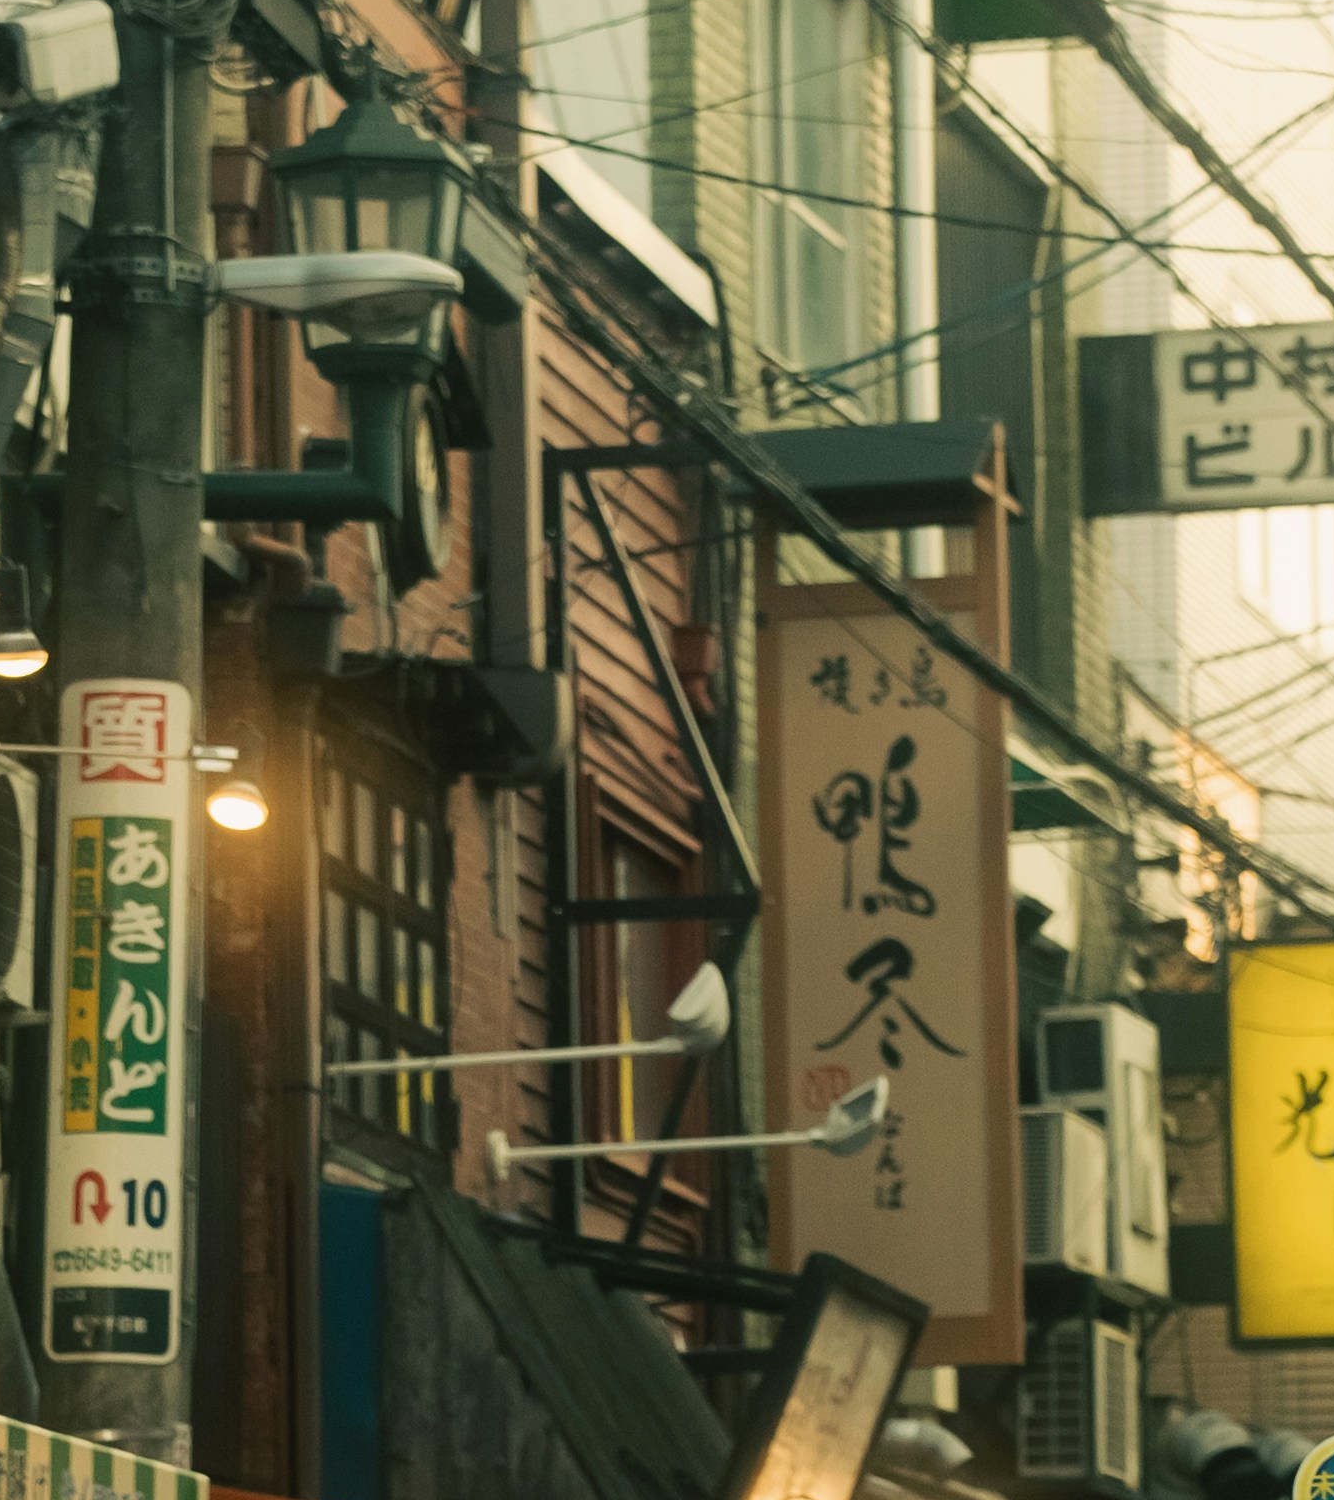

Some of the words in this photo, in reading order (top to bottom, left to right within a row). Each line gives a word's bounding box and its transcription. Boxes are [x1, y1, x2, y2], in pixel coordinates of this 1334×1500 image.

[84, 696, 164, 780] 質
[100, 822, 169, 1124] あきんど
[121, 1178, 168, 1230] 10
